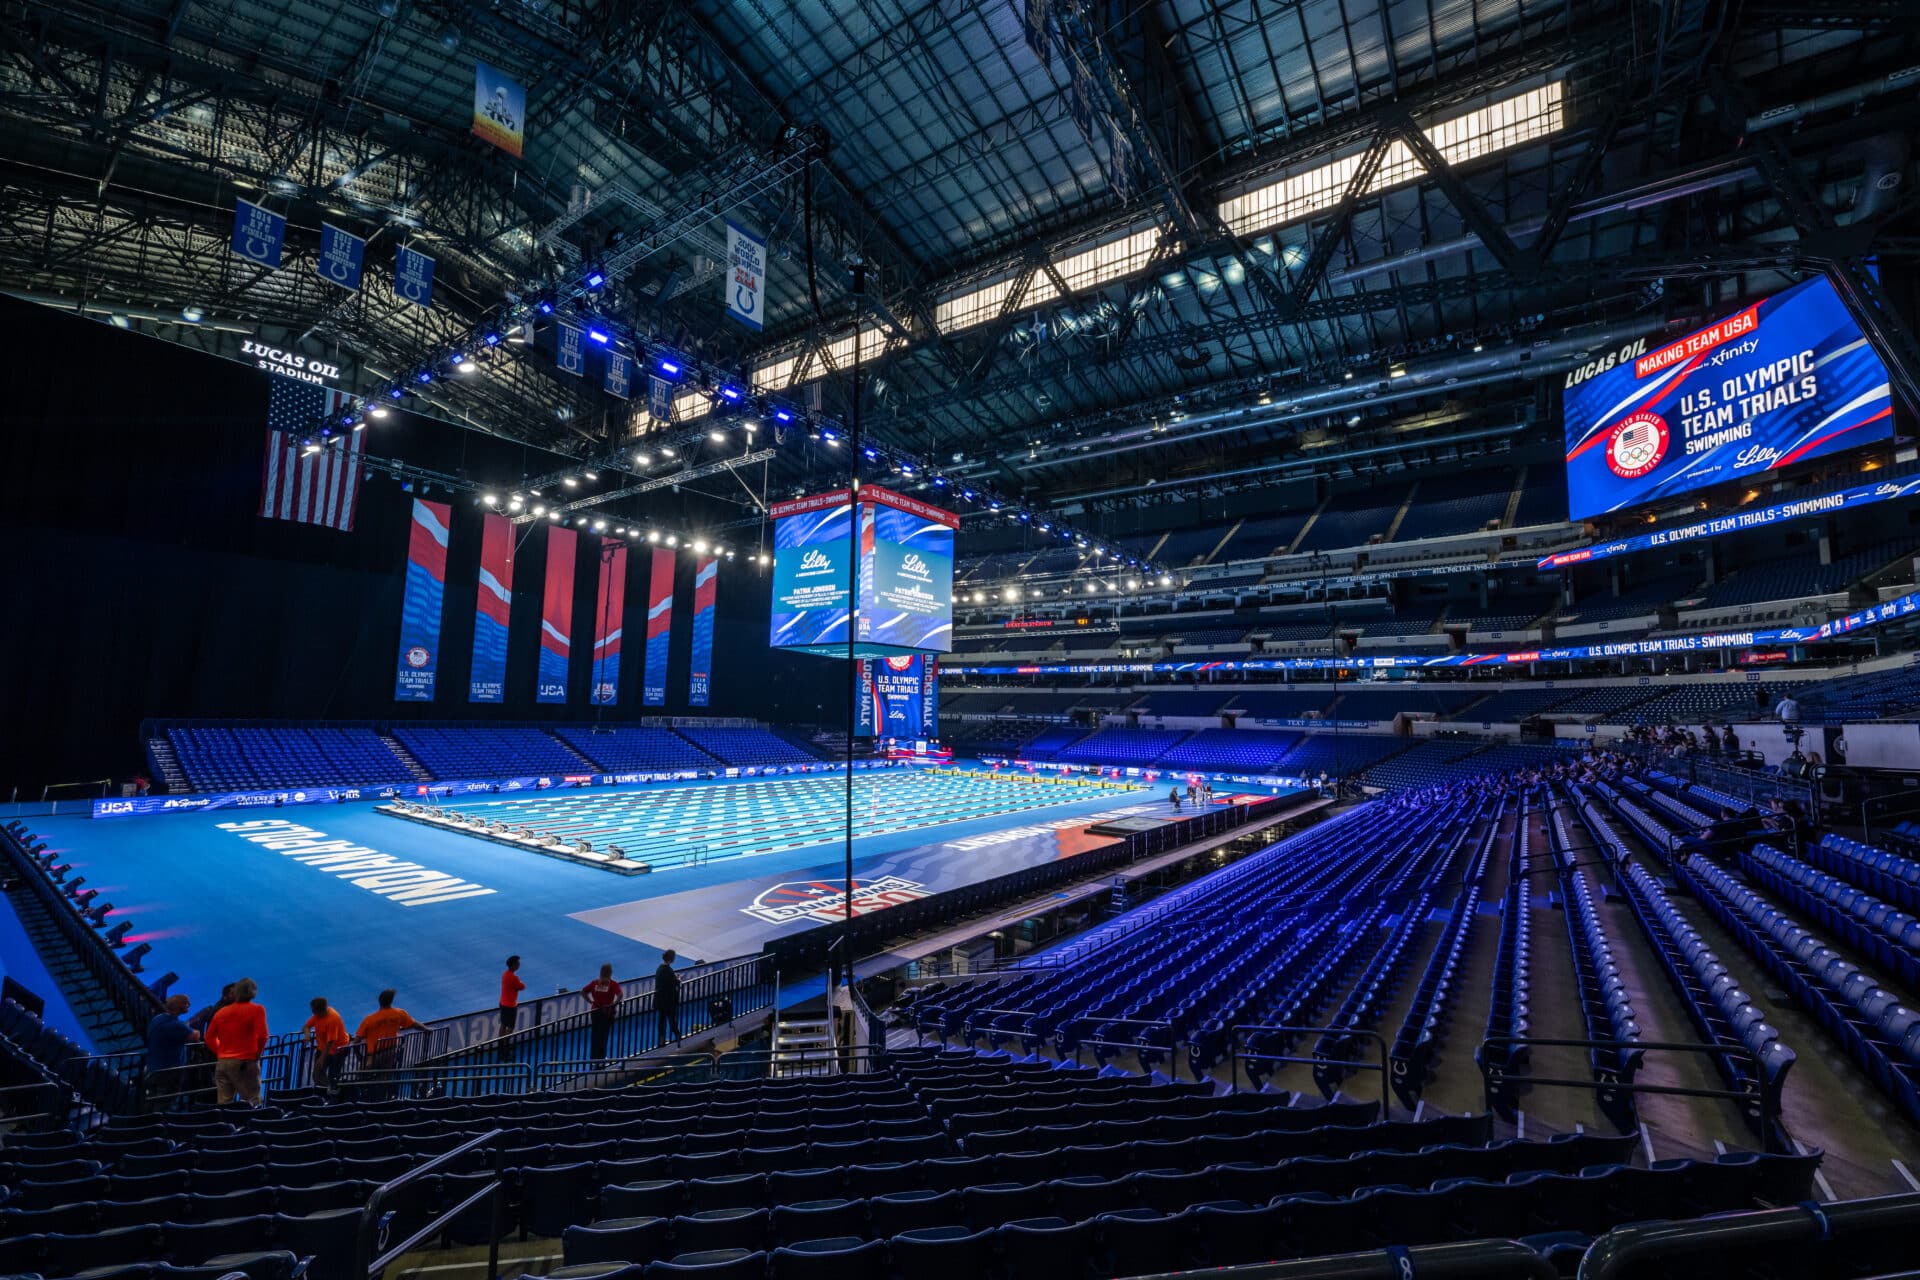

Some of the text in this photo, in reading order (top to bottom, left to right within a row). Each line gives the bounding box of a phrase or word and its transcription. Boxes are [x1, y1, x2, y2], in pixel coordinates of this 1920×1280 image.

[241, 224, 276, 245] FINALIST
[734, 244, 760, 266] WORLD
[1638, 348, 1685, 375] MAKING
[1686, 328, 1721, 355] TEAM
[1723, 313, 1753, 338] USA
[1711, 338, 1760, 367] xfinity
[241, 340, 340, 379] LUCAS OIL
[1565, 337, 1648, 390] LUCAS OIL
[258, 360, 323, 385] STADIUM
[1681, 349, 1815, 416] U.S. OLYMPIC
[1681, 375, 1817, 438] TEAM TRIALS
[1611, 417, 1633, 440] UNITED
[1635, 413, 1661, 425] STATES
[1686, 422, 1752, 455] SWIMMING
[1644, 453, 1662, 470] TEAM
[1733, 444, 1783, 469] Lilly
[1614, 465, 1642, 477] OLYMPIC
[1875, 483, 1903, 497] Lilly
[1651, 533, 1667, 545] U.S.
[1669, 525, 1707, 542] OLYMPIC
[1709, 517, 1736, 533] TEAM
[800, 549, 831, 570] Lilly
[901, 553, 930, 578] Lilly
[1779, 629, 1802, 641] Lilly
[1588, 646, 1604, 657] U.S.
[1604, 643, 1637, 655] OLYMPIC
[1638, 640, 1662, 653] TEAM
[415, 677, 433, 685] TRIALS
[540, 685, 564, 696] USA
[691, 683, 707, 695] USA
[878, 675, 919, 685] U.S. OLYMPIC
[878, 684, 919, 694] TEAM TRIALS
[923, 654, 934, 728] BLOCKS WALK
[860, 658, 873, 727] LOCKS WALK
[467, 783, 490, 792] xfinity
[101, 799, 134, 814] USA
[215, 819, 498, 907] INDIANAPOLIS
